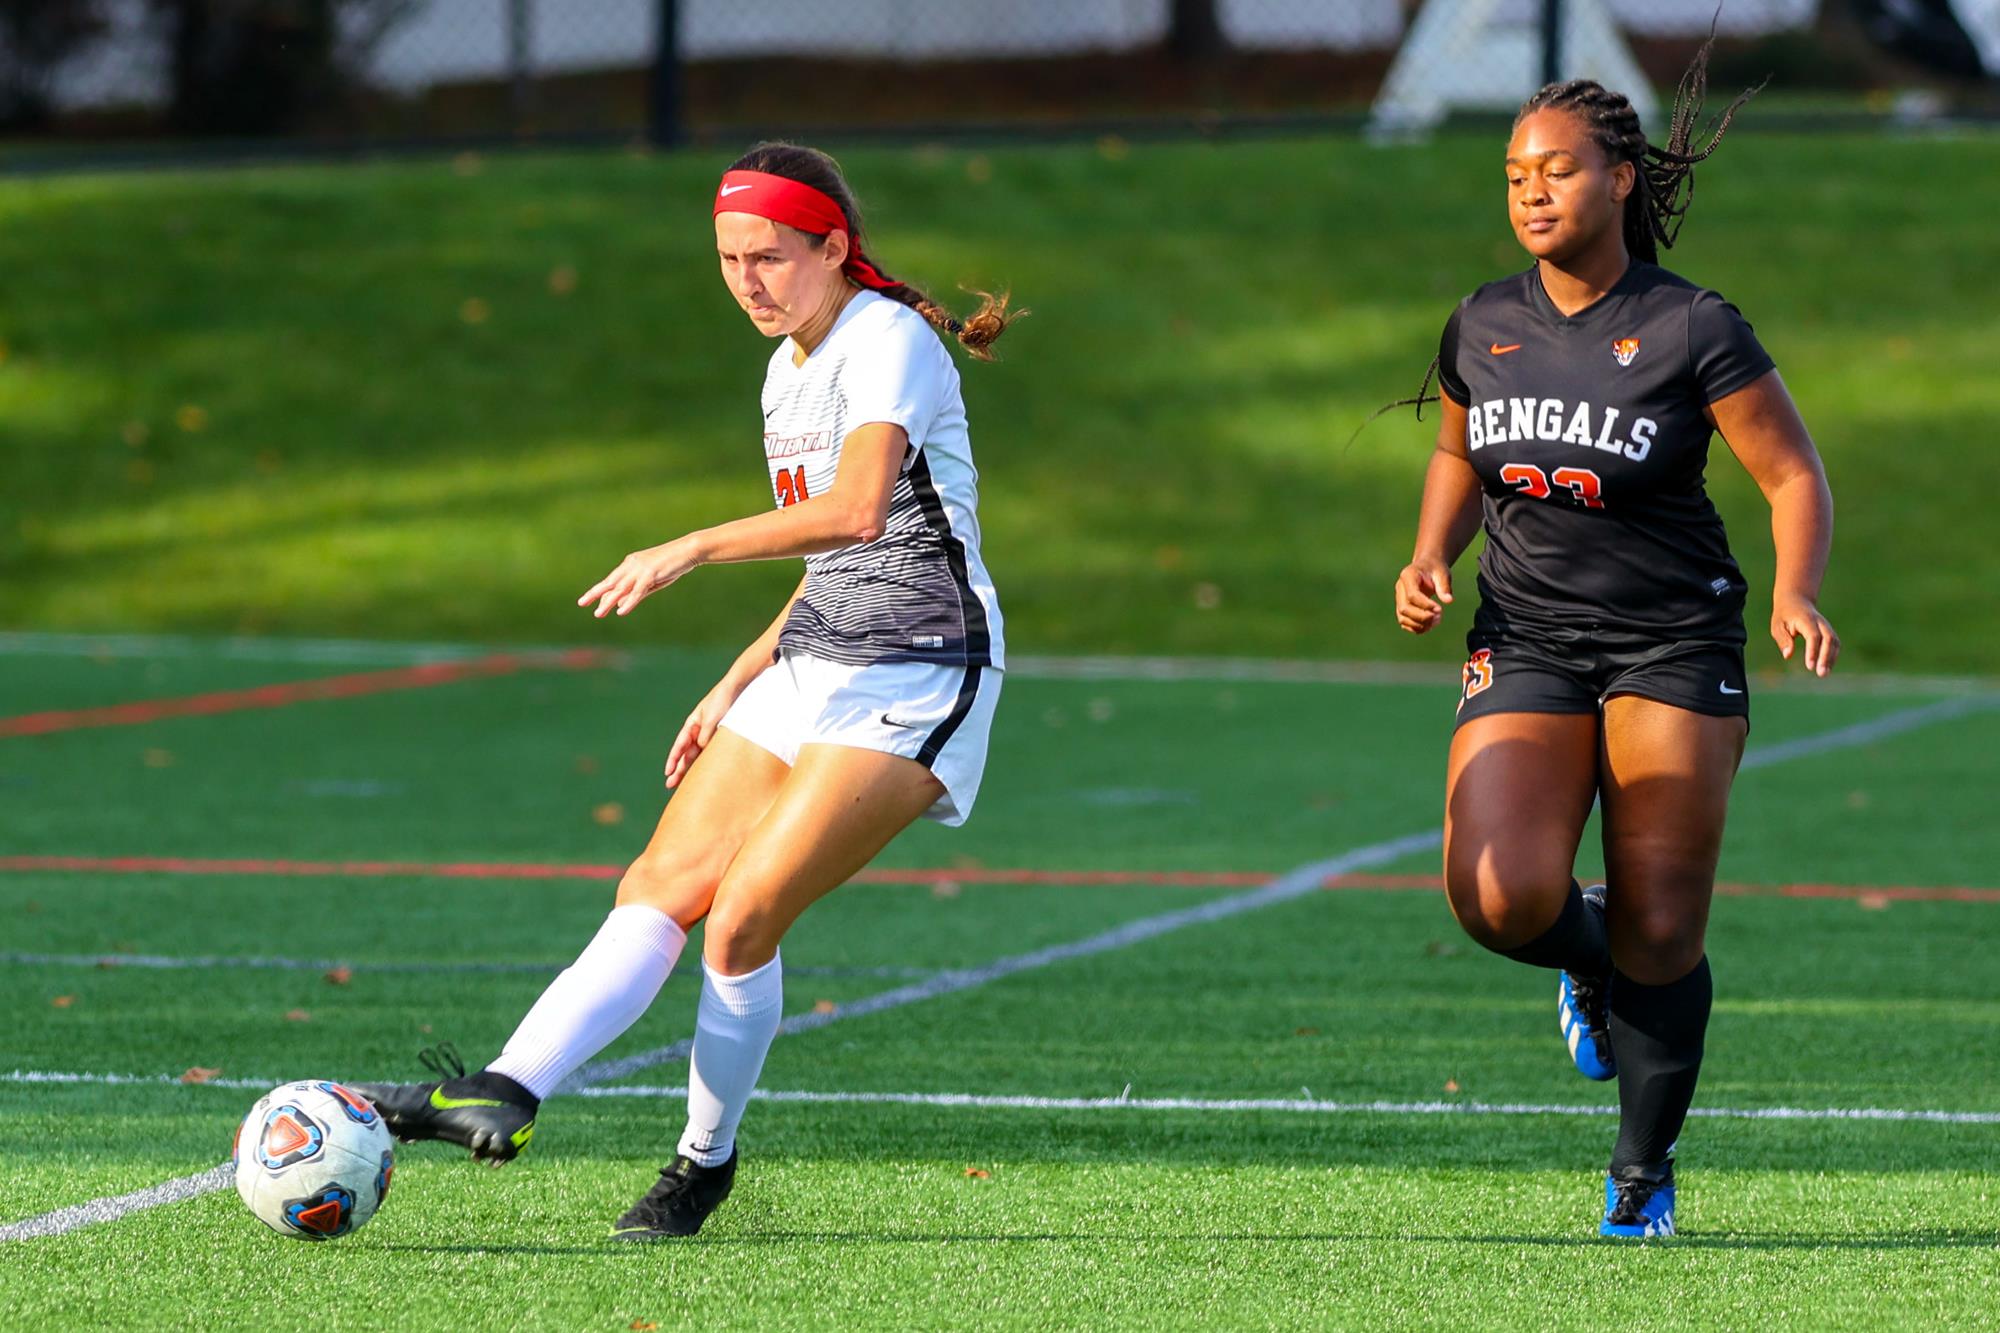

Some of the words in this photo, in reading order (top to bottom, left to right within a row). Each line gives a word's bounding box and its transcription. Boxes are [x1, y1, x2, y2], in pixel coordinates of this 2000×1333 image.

[1468, 397, 1658, 462] BENGALS
[776, 464, 809, 508] 21
[1457, 648, 1493, 716] 3
